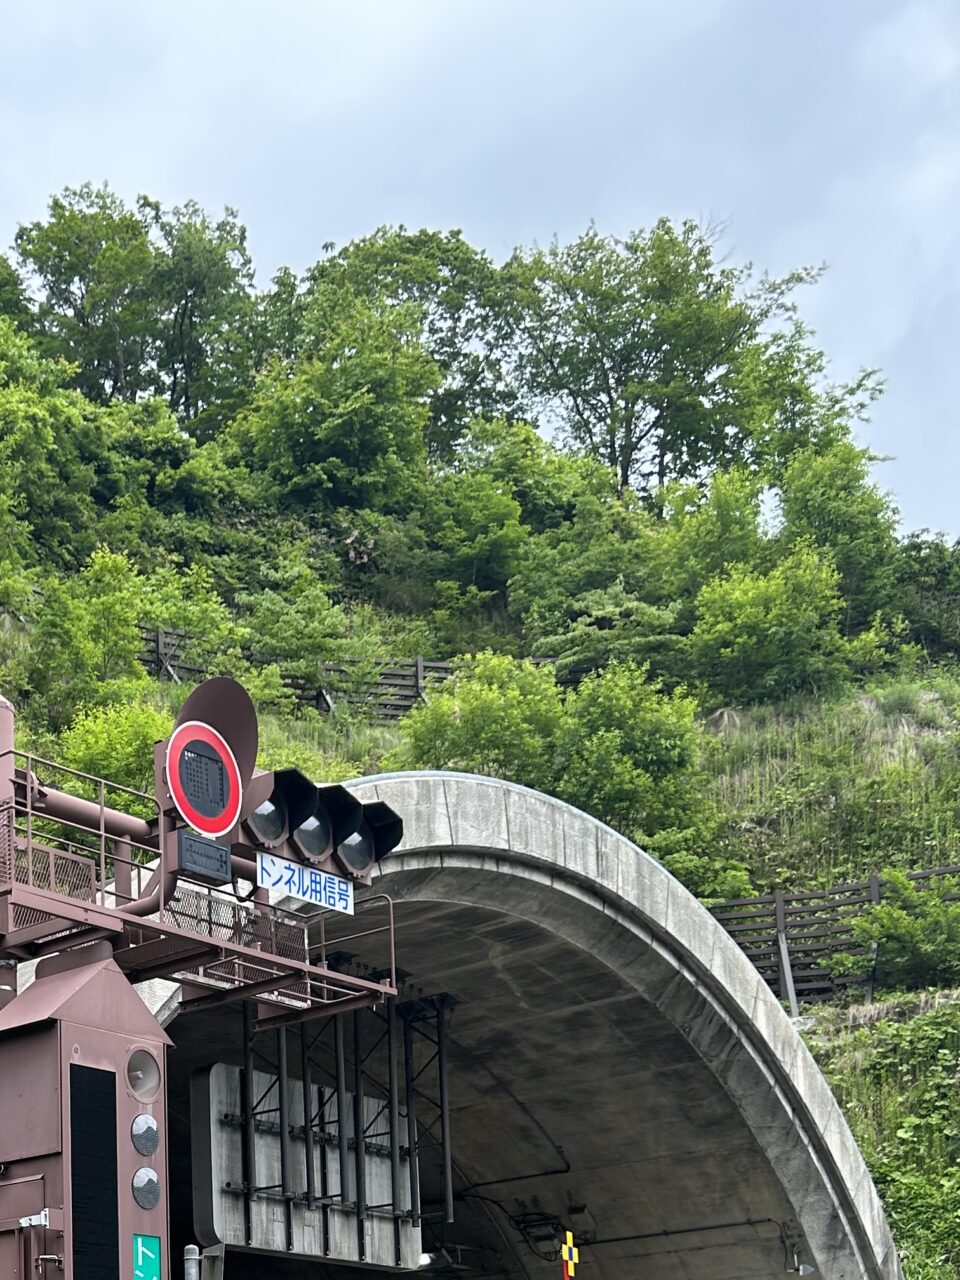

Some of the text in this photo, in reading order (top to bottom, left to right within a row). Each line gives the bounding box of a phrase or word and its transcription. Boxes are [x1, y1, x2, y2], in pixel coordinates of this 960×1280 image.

[260, 855, 350, 911] トンネル用信号
